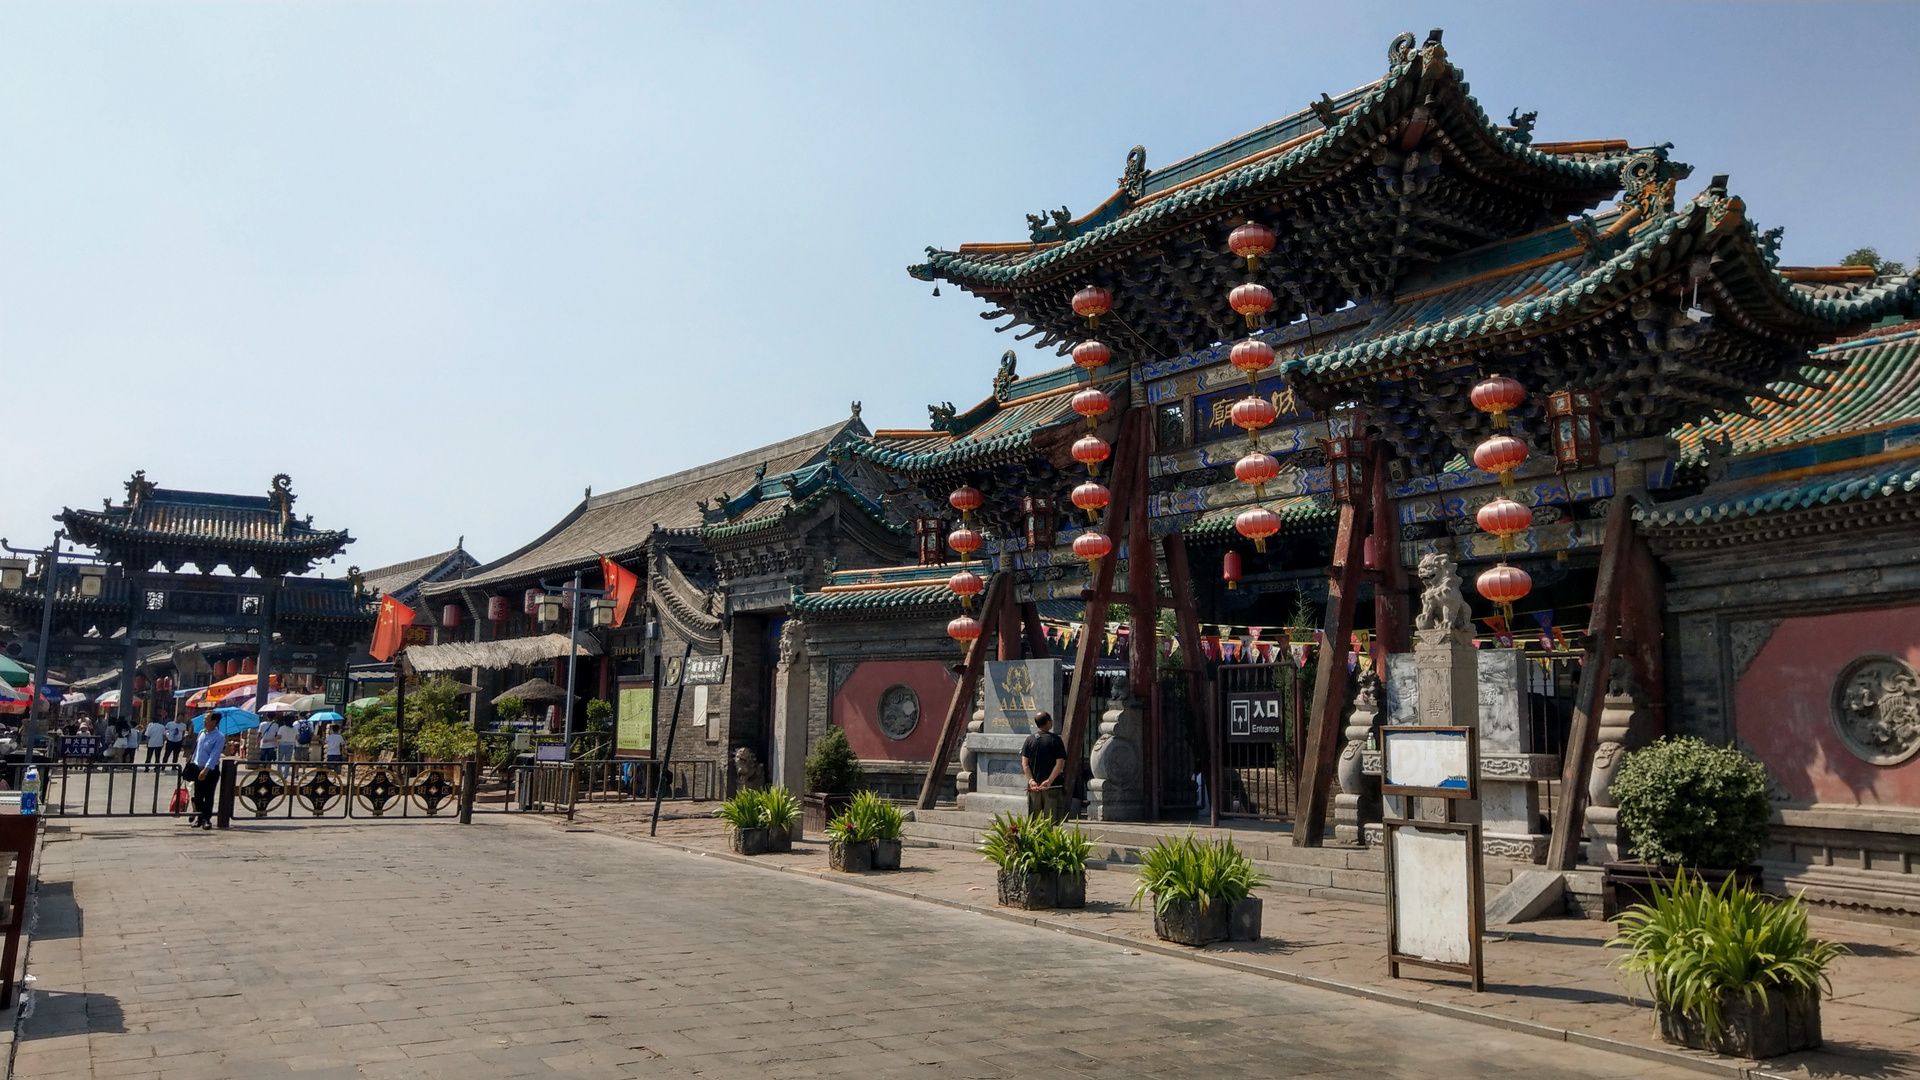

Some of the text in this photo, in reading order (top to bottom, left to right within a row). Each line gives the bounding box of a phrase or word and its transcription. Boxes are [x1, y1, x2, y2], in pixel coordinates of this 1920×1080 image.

[1000, 696, 1037, 711] AAAA
[1253, 700, 1279, 718] 入口
[1252, 724, 1280, 733] Entrance
